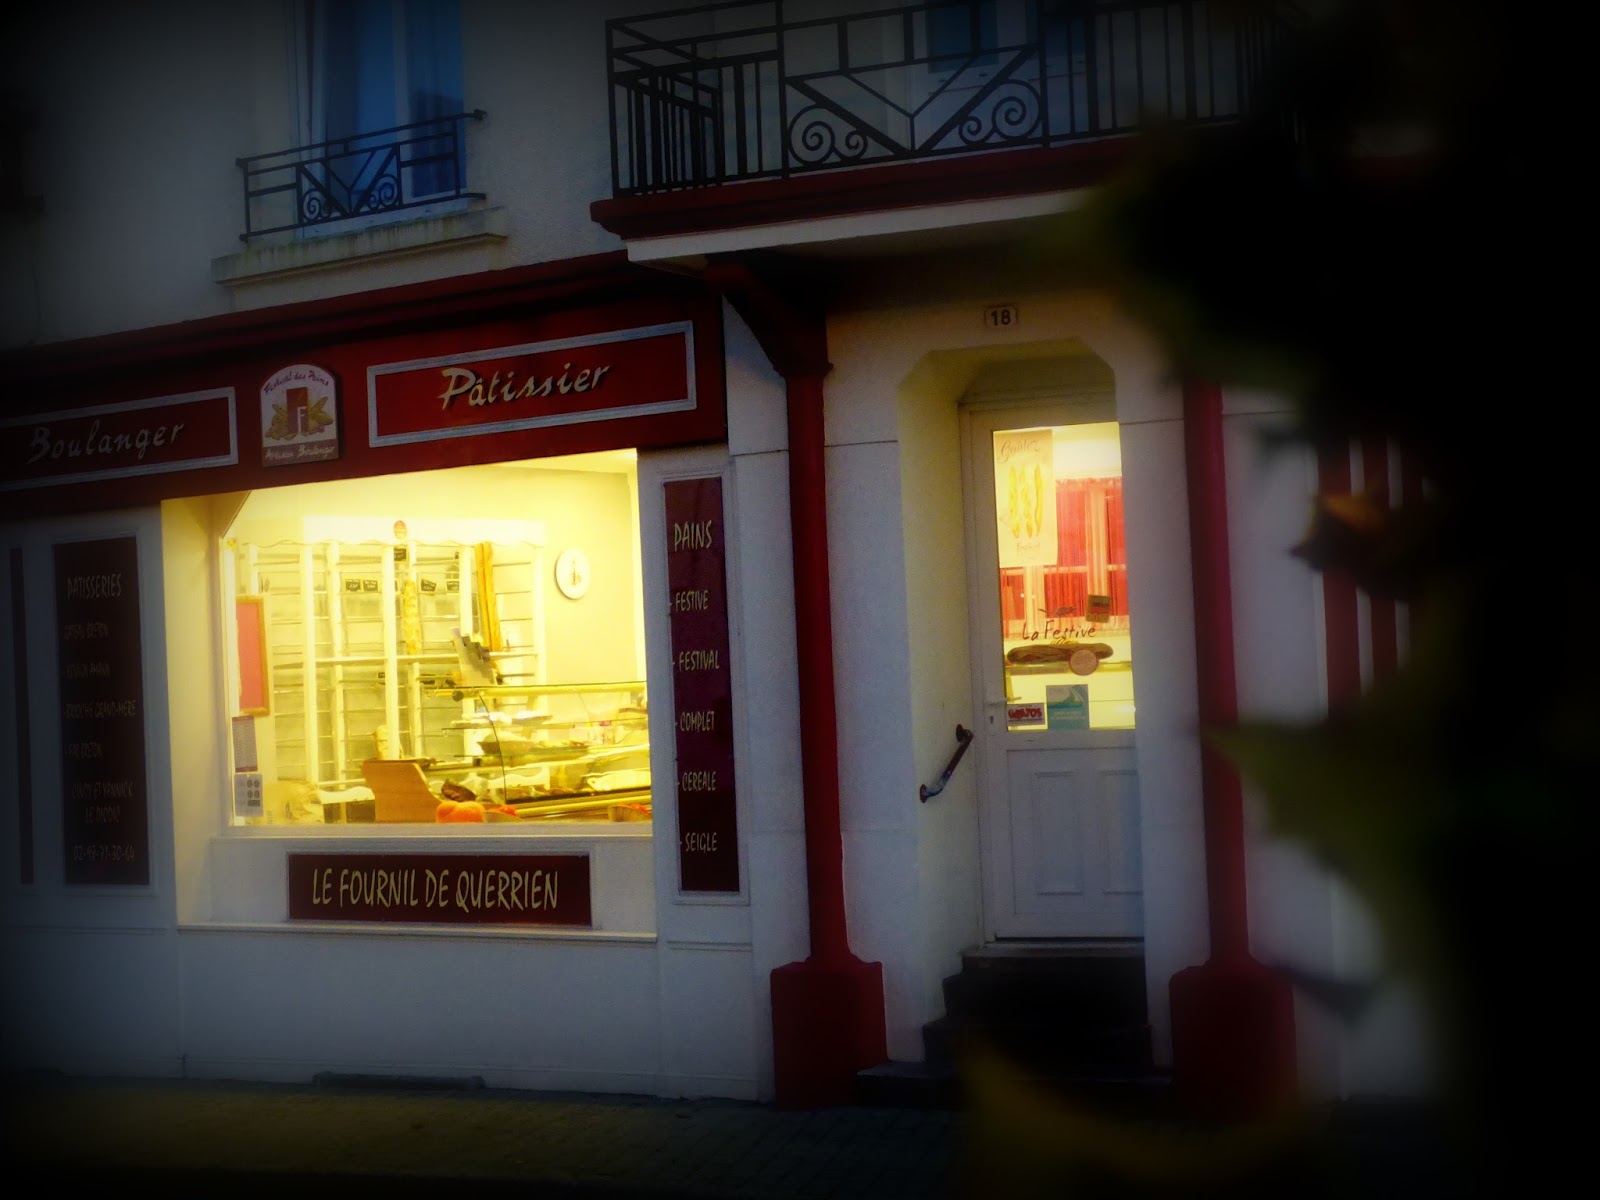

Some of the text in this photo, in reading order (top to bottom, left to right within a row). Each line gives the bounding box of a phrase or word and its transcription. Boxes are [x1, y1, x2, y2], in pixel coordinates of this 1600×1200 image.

[991, 310, 1010, 325] 18
[294, 371, 306, 380] des
[308, 369, 329, 386] Pains
[438, 363, 610, 410] Pâtissier
[26, 418, 184, 460] Boulanger
[674, 520, 713, 552] PAINS
[67, 573, 122, 600] PATISSERIES
[675, 590, 709, 612] FESTIVE
[1022, 619, 1097, 641] La Festive
[678, 650, 720, 672] FESTIVAL
[680, 710, 716, 732] COMPLET
[681, 771, 717, 792] CEREALE
[685, 832, 718, 852] SEIGLE
[312, 867, 559, 913] LE FOURNIL DE QUERRIEN
